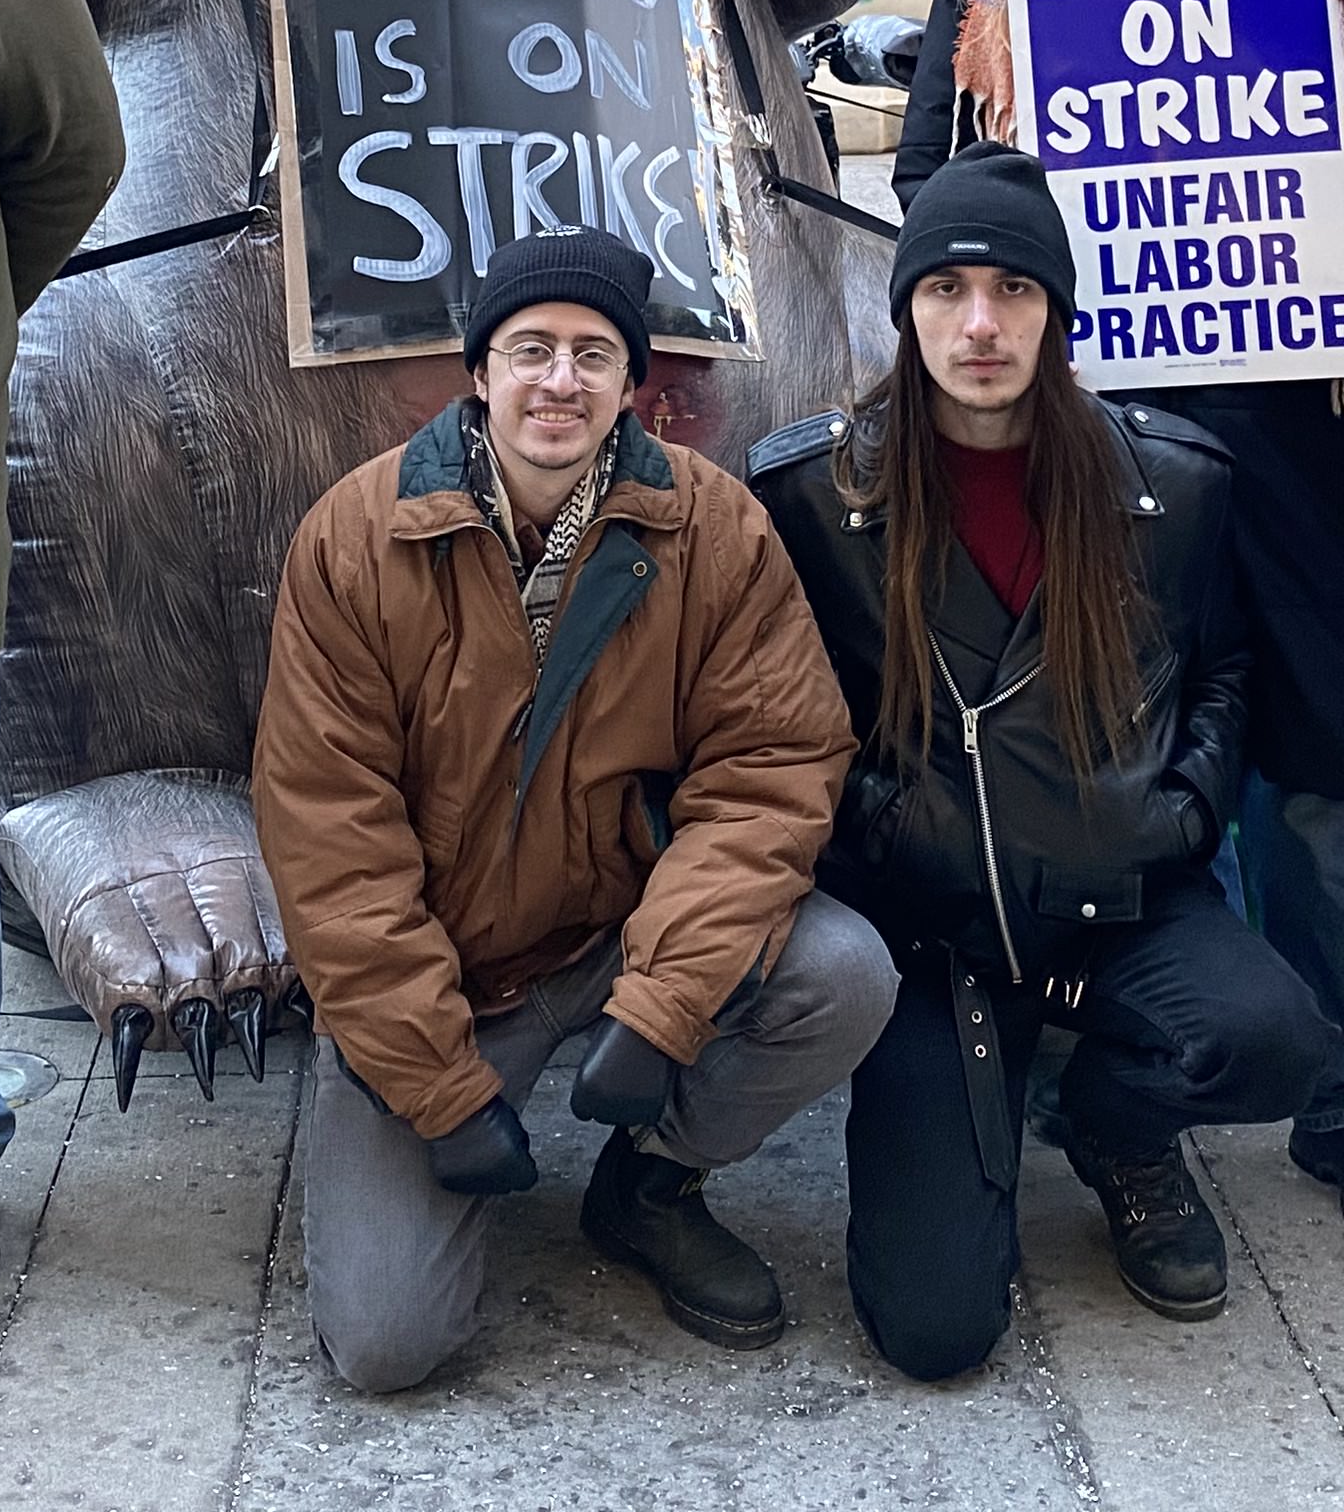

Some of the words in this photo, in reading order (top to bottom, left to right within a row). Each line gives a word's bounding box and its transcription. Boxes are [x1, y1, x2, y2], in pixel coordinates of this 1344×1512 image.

[334, 18, 428, 116] IS
[507, 21, 652, 111] ON
[1046, 68, 1329, 155] STRIKE
[337, 127, 697, 292] STRIKE
[1083, 167, 1305, 233] UNFAIR
[1098, 233, 1301, 296] LABOR
